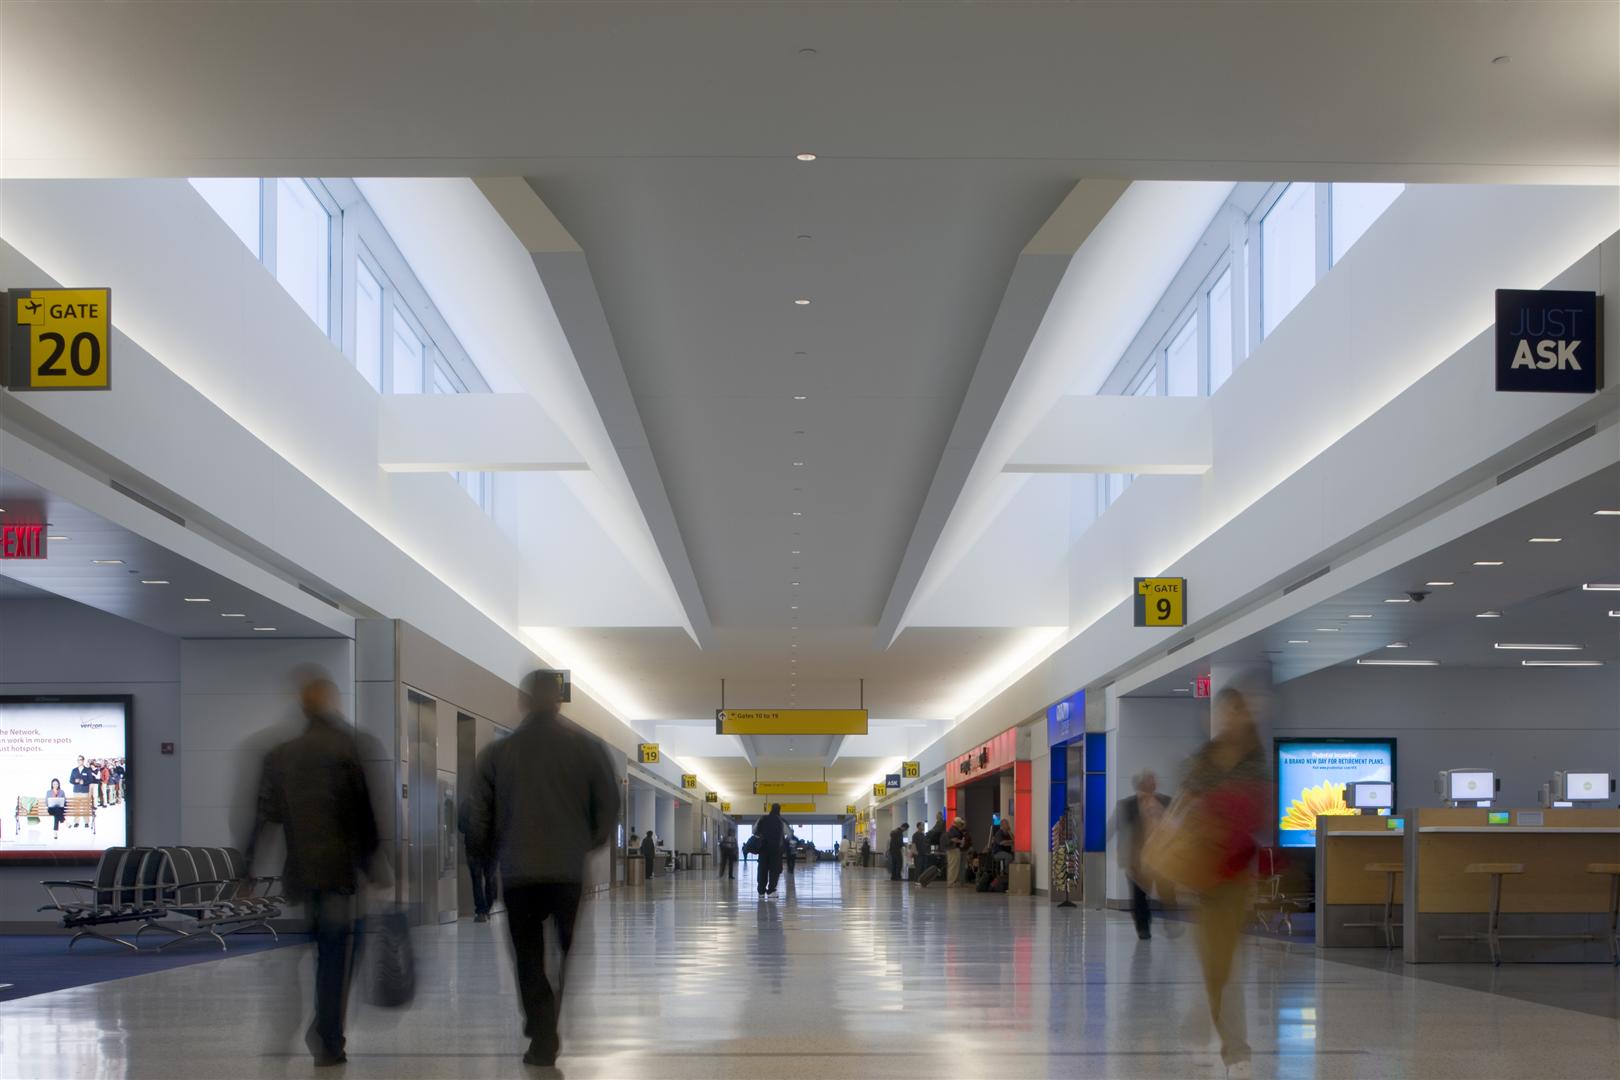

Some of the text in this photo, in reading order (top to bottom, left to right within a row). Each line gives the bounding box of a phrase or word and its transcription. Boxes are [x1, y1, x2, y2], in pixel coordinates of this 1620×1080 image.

[50, 304, 98, 319] GATE
[1510, 308, 1583, 337] JUST
[37, 331, 101, 377] 20
[1510, 339, 1583, 371] ASK
[3, 527, 42, 557] EXIT
[1154, 584, 1179, 593] GATE
[1156, 598, 1171, 620] 9
[1197, 679, 1210, 697] EX
[646, 752, 657, 761] 19
[907, 767, 917, 776] 10
